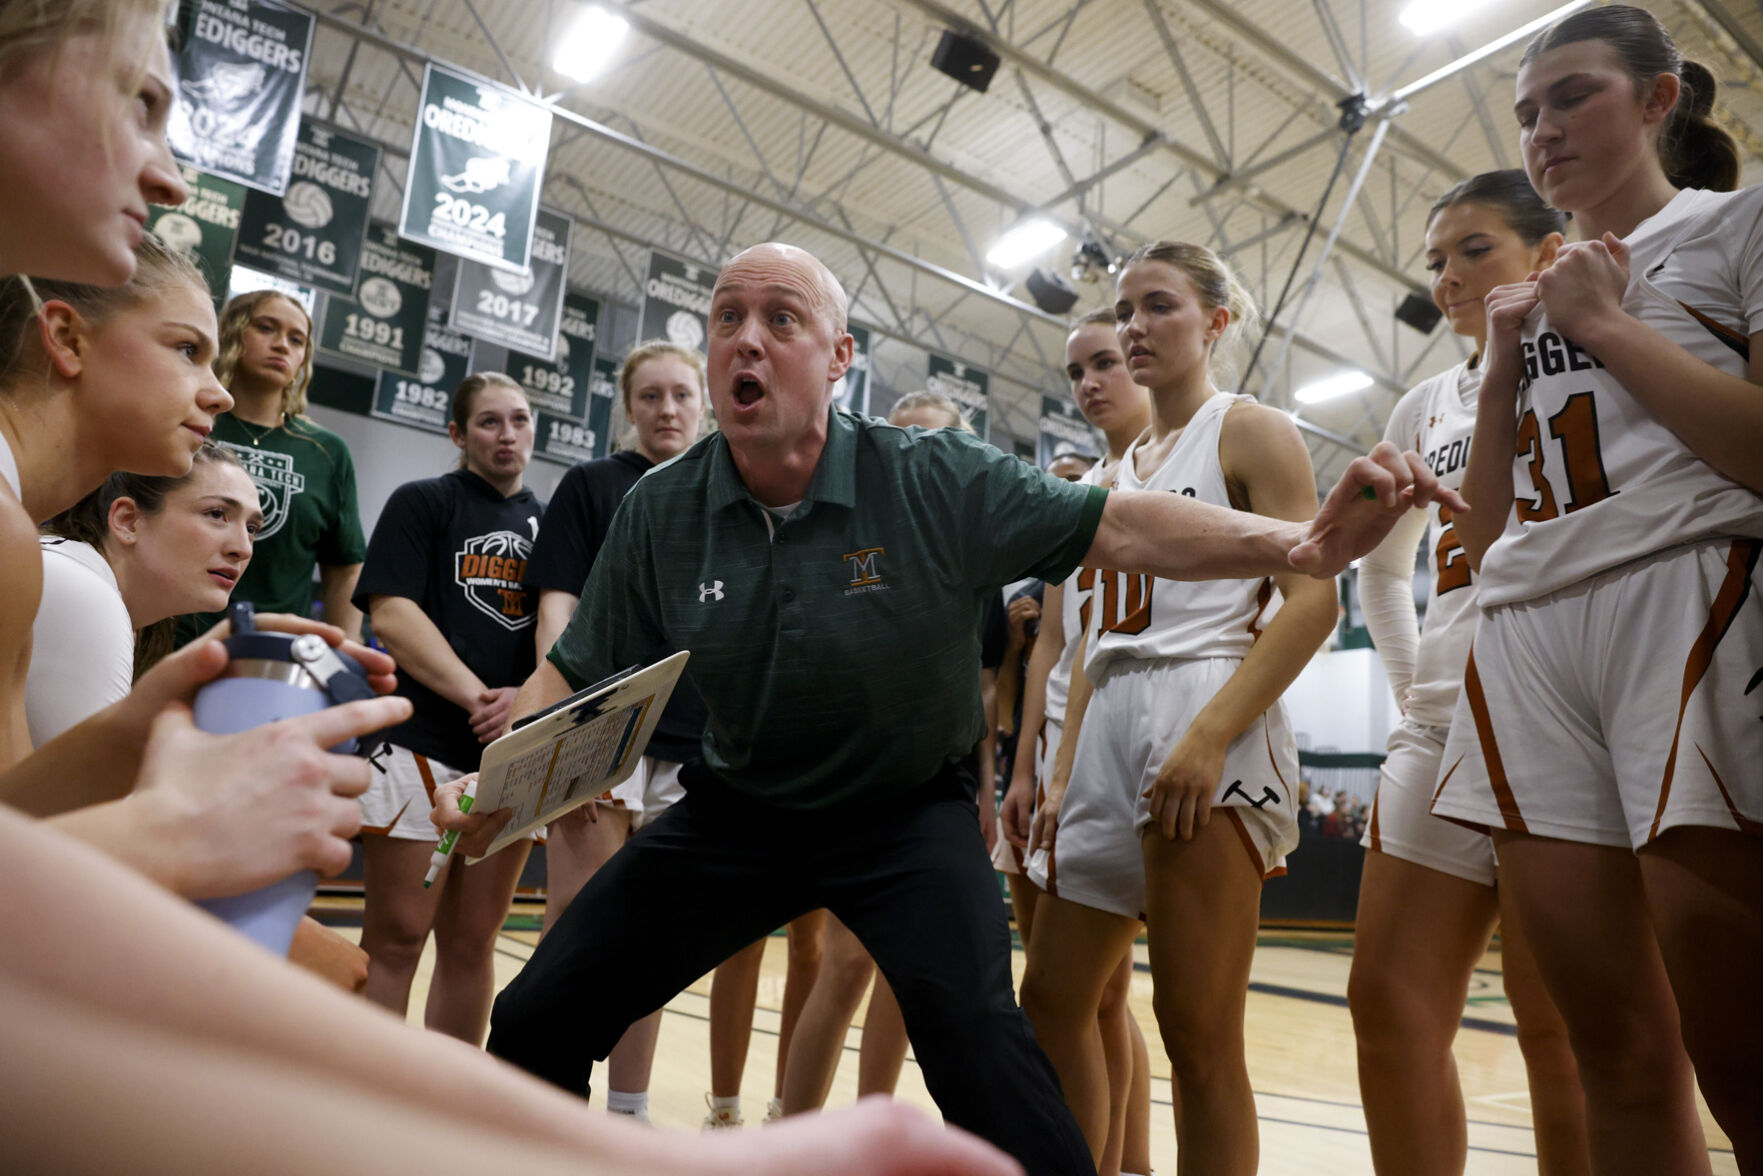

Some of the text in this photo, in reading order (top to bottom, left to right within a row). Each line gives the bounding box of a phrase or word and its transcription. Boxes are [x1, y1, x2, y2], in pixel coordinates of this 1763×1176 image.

[431, 191, 507, 239] 2024
[263, 222, 337, 266] 2016
[477, 289, 539, 327] 2017
[344, 313, 404, 351] 1991
[395, 380, 449, 411] 1982
[522, 365, 575, 398] 1992
[549, 421, 597, 449] 1983
[1517, 390, 1620, 525] 31
